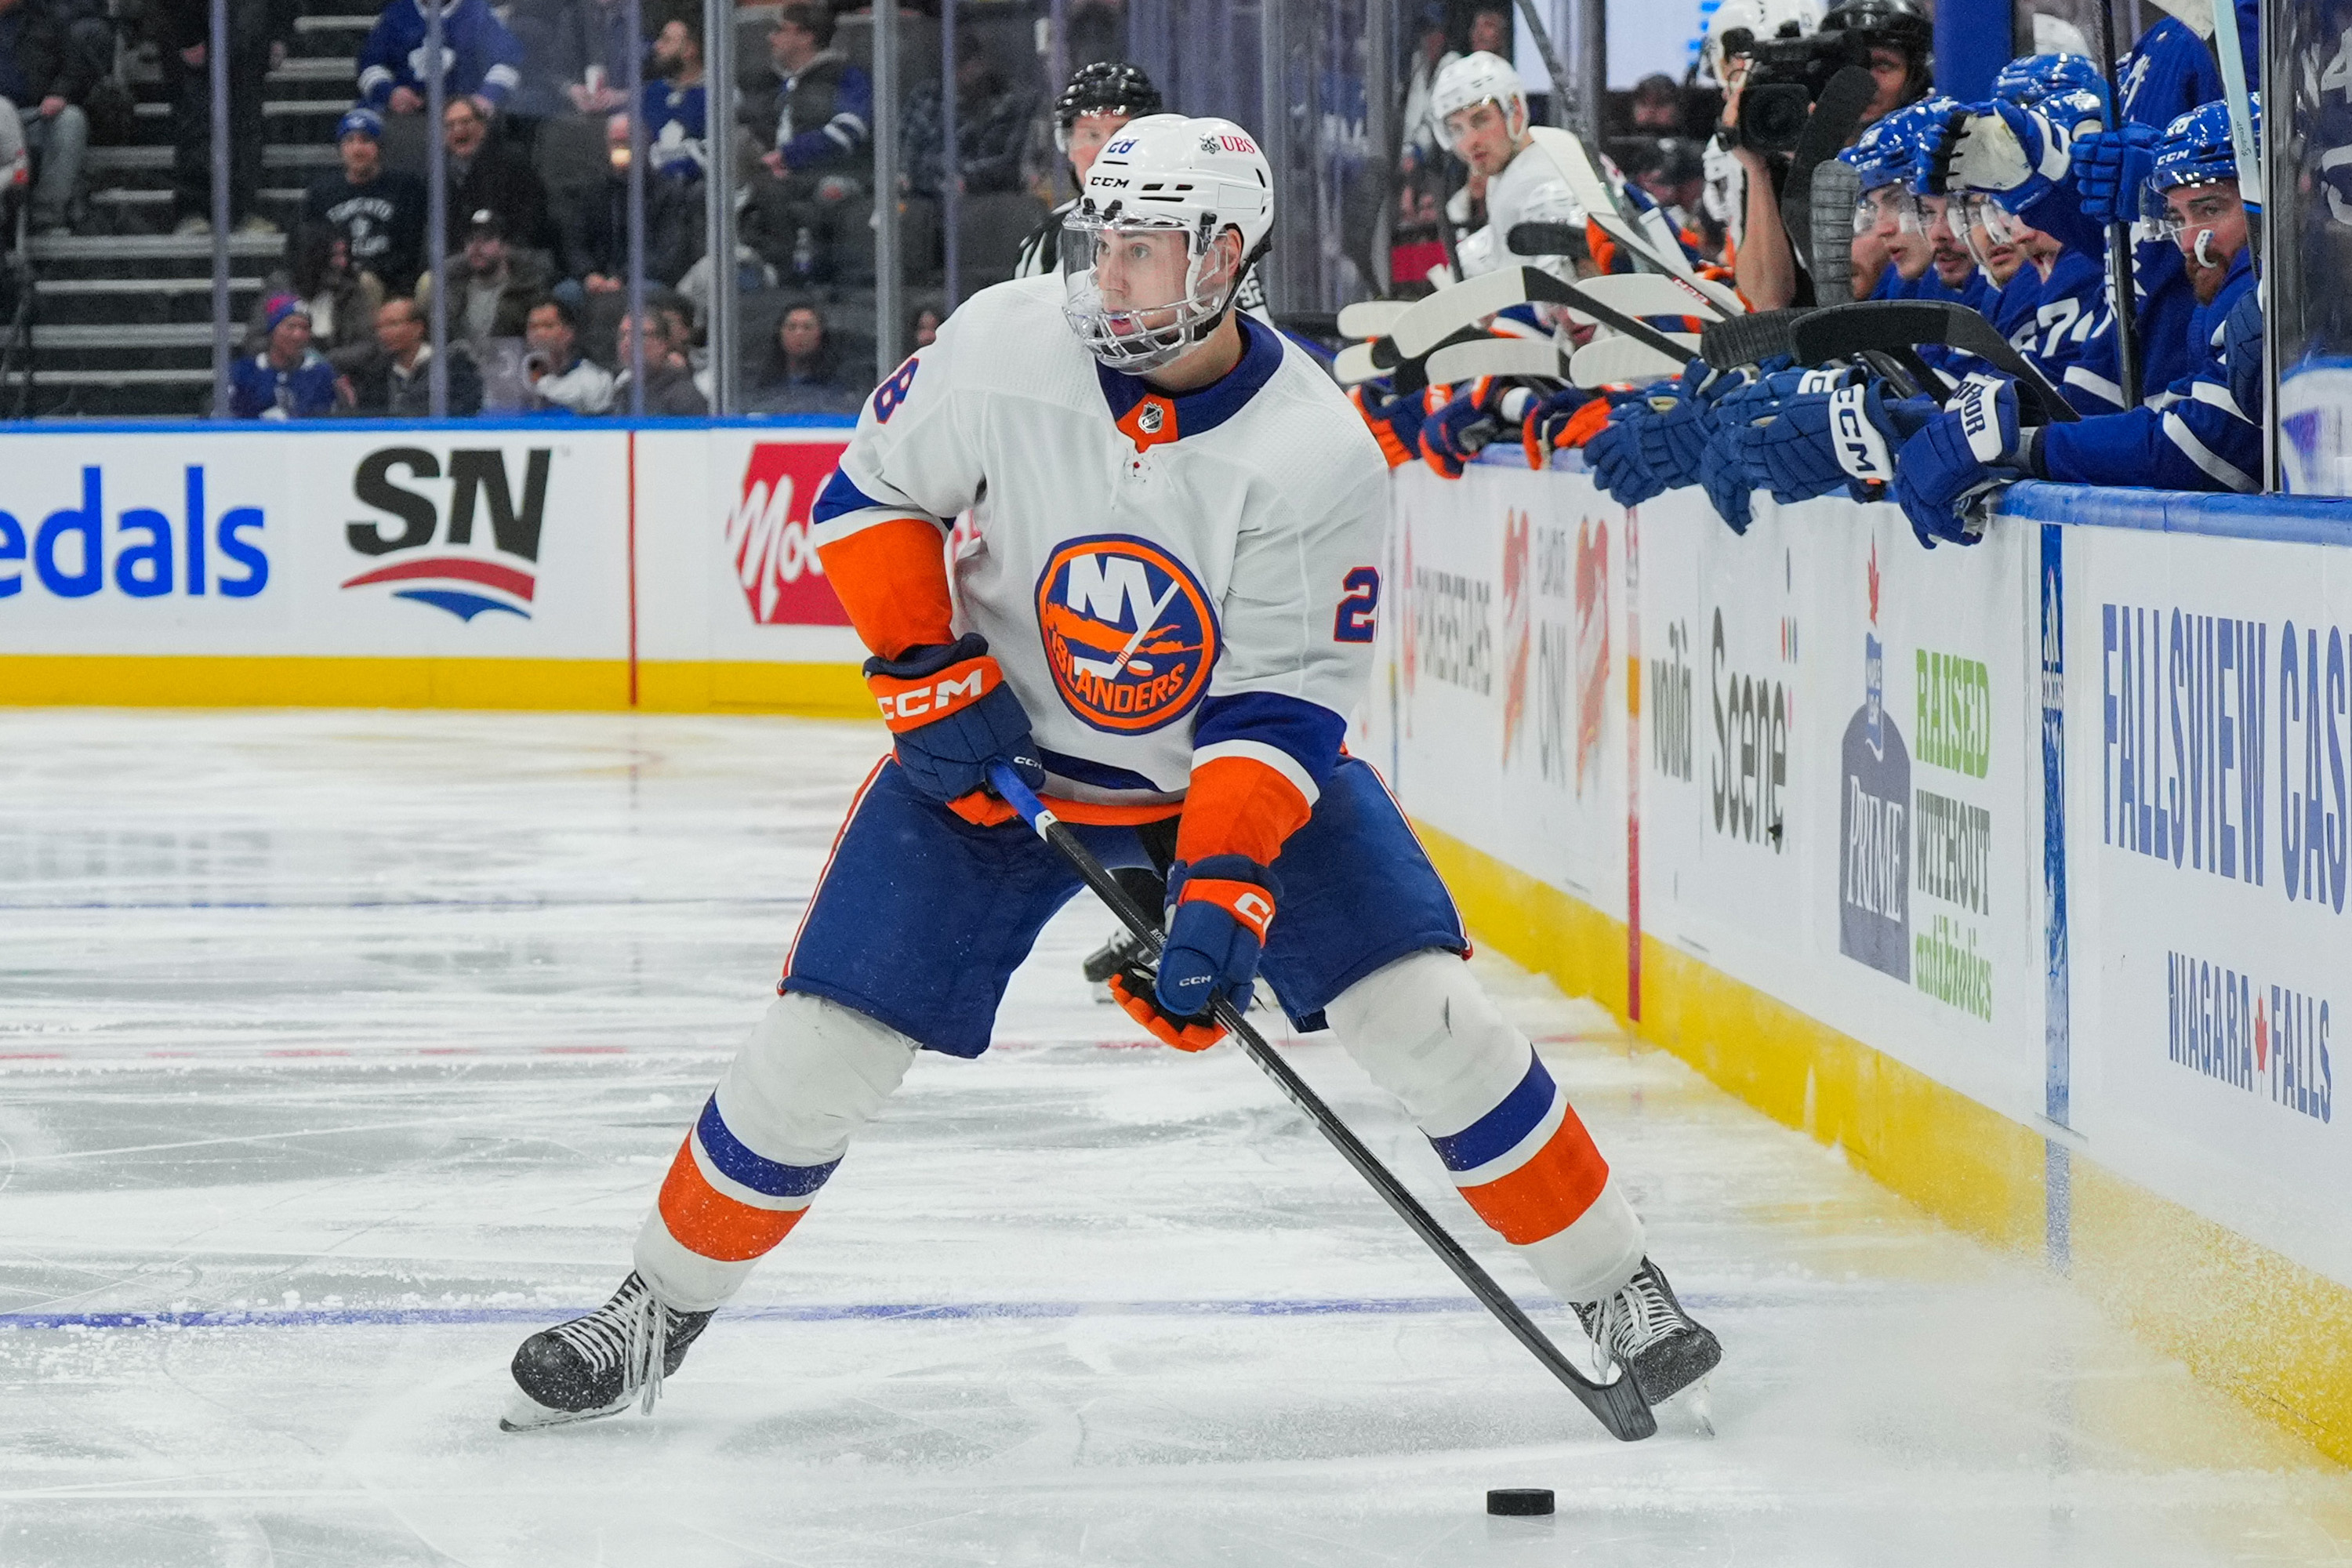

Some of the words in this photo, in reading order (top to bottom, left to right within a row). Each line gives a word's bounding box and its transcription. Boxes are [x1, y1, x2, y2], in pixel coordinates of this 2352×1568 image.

[1090, 176, 1130, 188] CCM
[1219, 135, 1255, 154] UBS
[2157, 149, 2190, 165] CCM
[873, 357, 920, 425] 8
[1838, 388, 1877, 472] CCM
[345, 446, 553, 563] SN
[1066, 553, 1181, 655] NY
[1334, 566, 1380, 643] 2
[877, 669, 982, 720] CCM
[1051, 629, 1186, 713] ISLANDERS
[1916, 648, 1991, 779] RAISED
[2102, 603, 2267, 887] FALLSVIEW
[1846, 775, 1904, 924] PRIME
[1915, 788, 1991, 917] WITHOUT
[1915, 913, 1991, 1023] antibiotics
[2168, 949, 2253, 1093] NIAGARA
[2270, 983, 2332, 1124] FALLS
